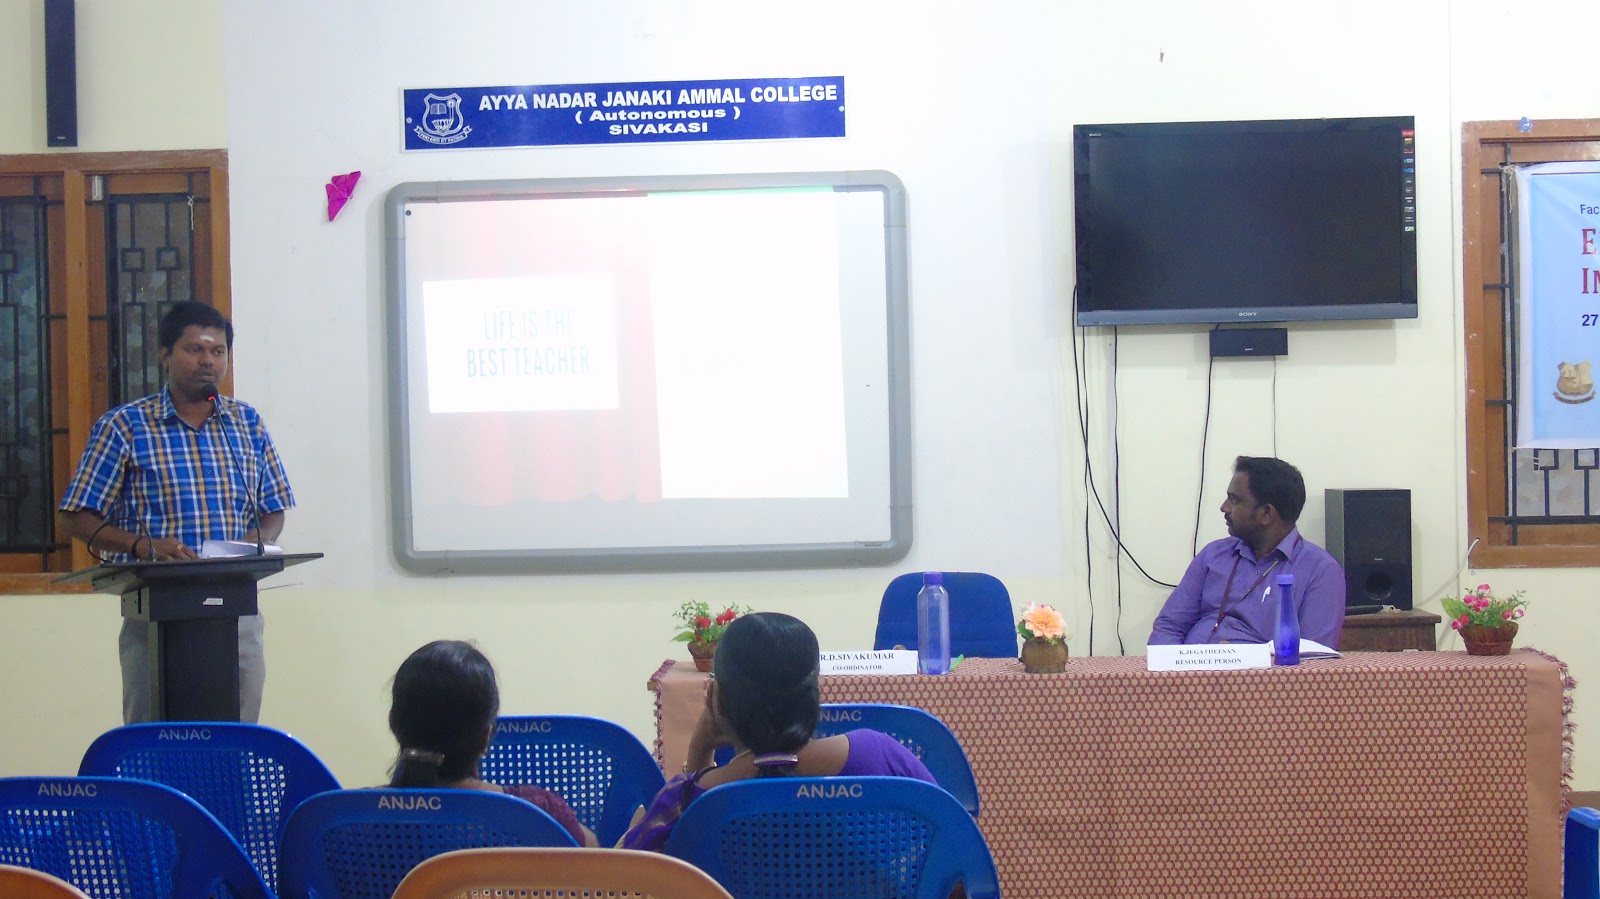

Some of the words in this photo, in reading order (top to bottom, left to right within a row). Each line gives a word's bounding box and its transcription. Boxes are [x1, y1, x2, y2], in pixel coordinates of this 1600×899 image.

[479, 94, 528, 111] AYYA
[533, 91, 598, 109] NADAR
[602, 89, 672, 107] JANAKI
[677, 87, 746, 105] AMMAL
[750, 84, 838, 103] COLLEGE
[589, 108, 727, 122] Autonomous
[609, 122, 708, 136] SIVAKASI
[1581, 228, 1600, 255] E
[484, 309, 516, 339] LIFE
[523, 309, 538, 337] IS
[1582, 314, 1599, 327] 27
[467, 347, 507, 378] BEST
[513, 344, 591, 377] TEACHER
[818, 709, 862, 722] NJAC
[497, 721, 552, 733] ANJAC
[158, 728, 212, 741] ANJAC
[37, 783, 98, 797] ANJAC
[796, 783, 863, 798] ANJAC
[378, 795, 442, 810] ANJAC
